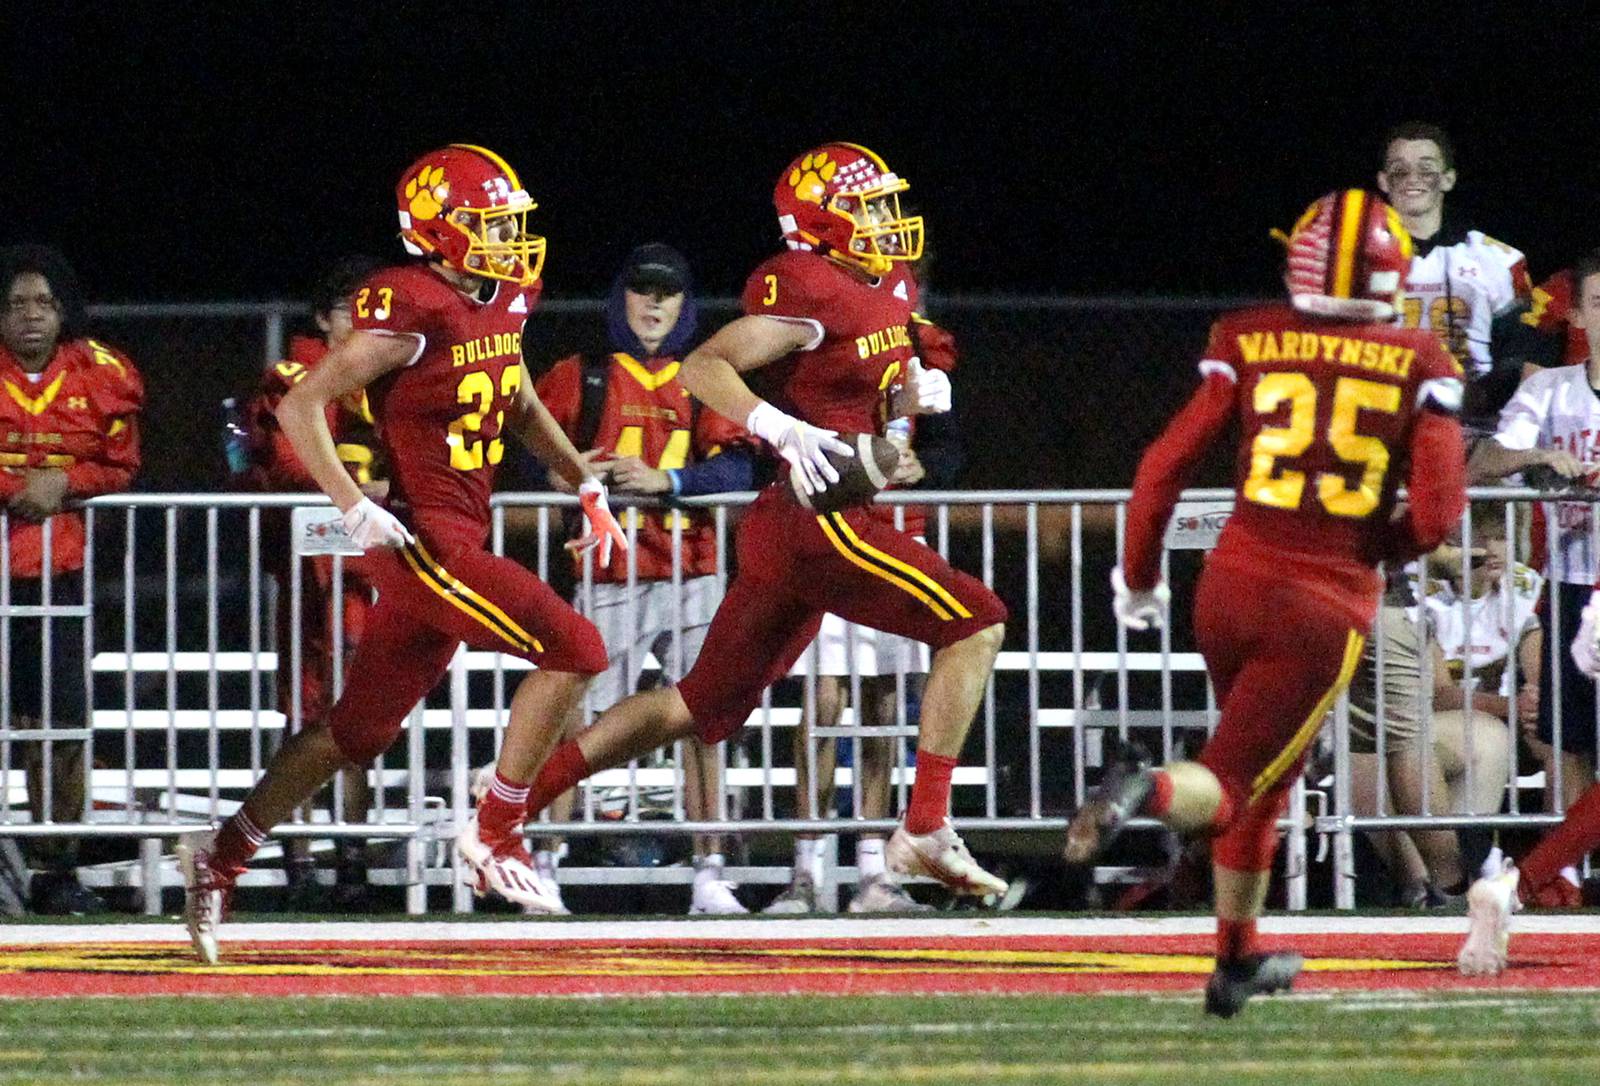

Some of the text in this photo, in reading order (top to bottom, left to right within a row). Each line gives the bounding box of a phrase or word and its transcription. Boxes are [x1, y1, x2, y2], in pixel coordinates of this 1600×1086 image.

[355, 287, 394, 320] 23
[763, 274, 778, 306] 3
[451, 332, 521, 367] BULLDOG
[1237, 330, 1416, 379] WARDYNSKI
[1243, 372, 1401, 518] 25
